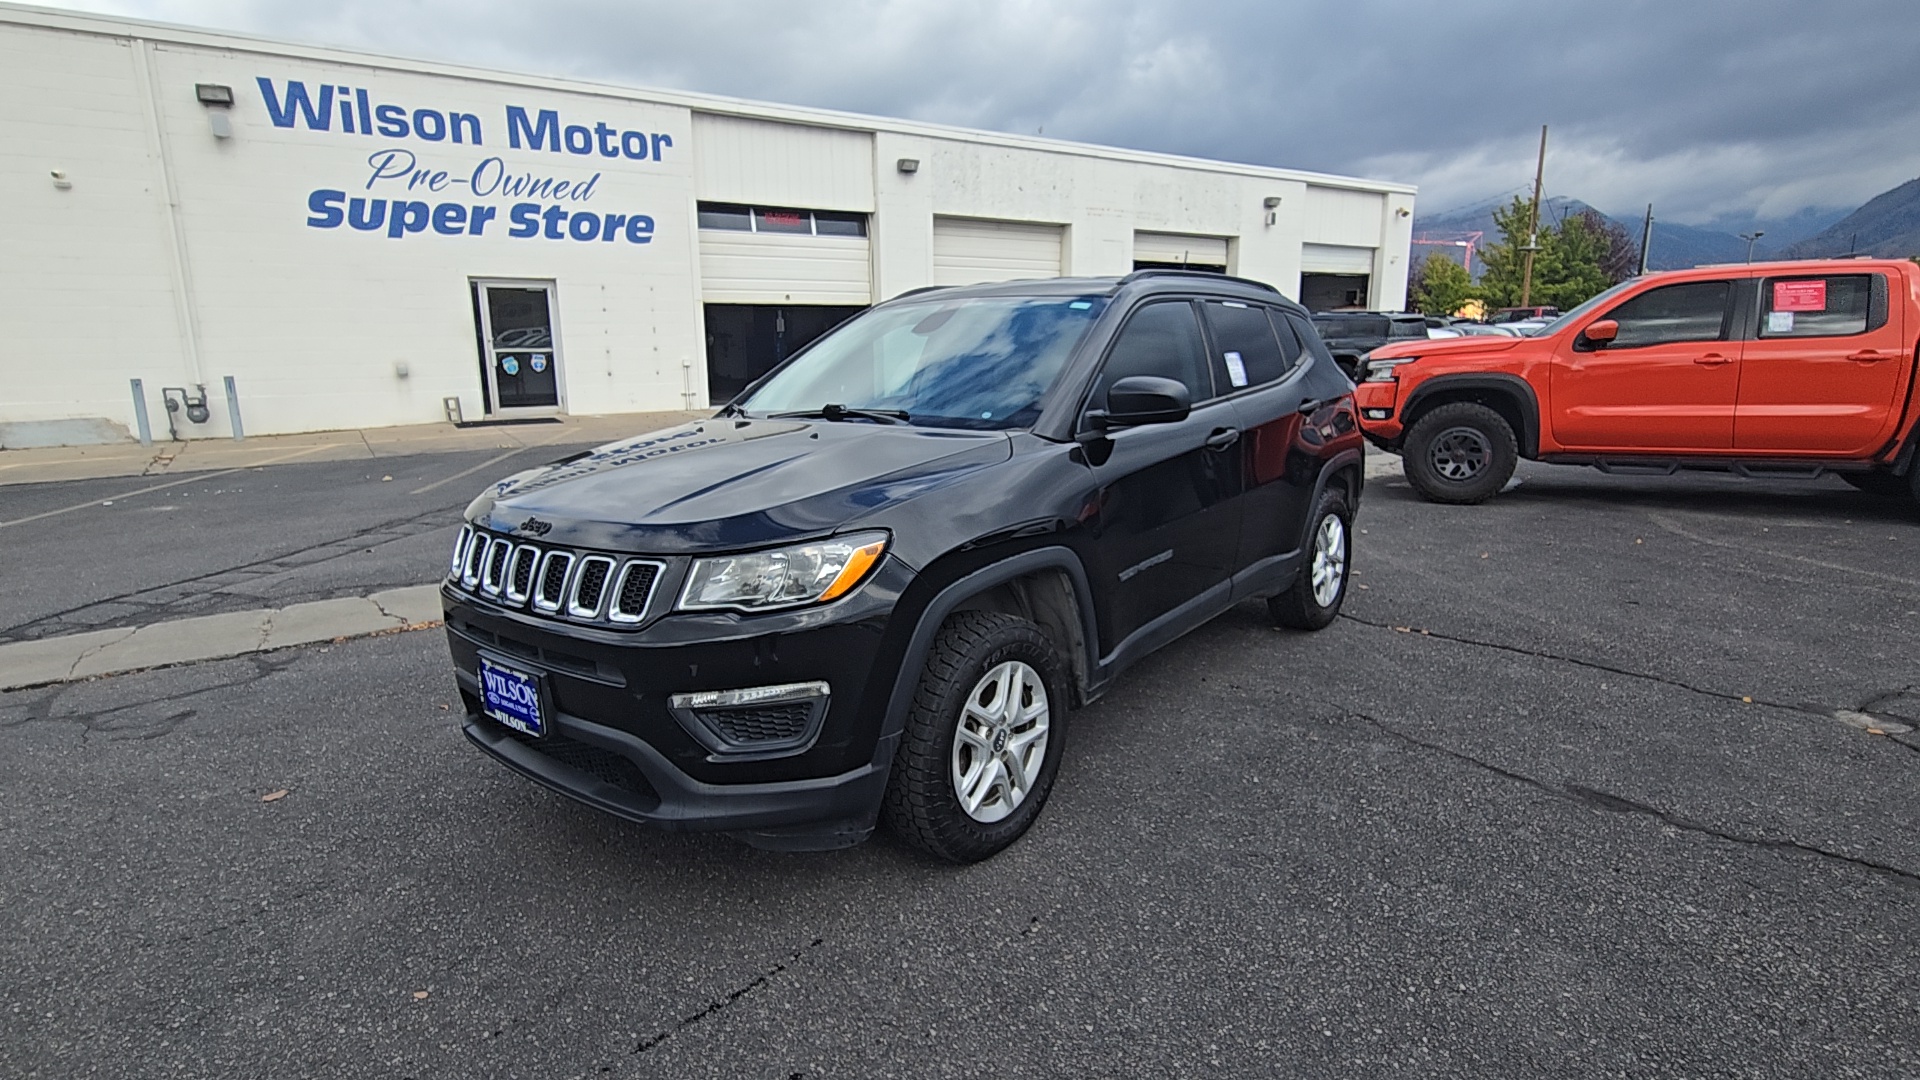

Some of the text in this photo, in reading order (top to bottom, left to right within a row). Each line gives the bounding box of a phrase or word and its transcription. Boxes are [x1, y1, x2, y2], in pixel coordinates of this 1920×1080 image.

[255, 75, 673, 162] Wilson Motor
[365, 148, 601, 202] Pre-Owned
[306, 188, 656, 244] Super Store
[520, 516, 552, 537] Jeep
[482, 670, 539, 708] WILSON
[494, 709, 527, 732] WILSON
